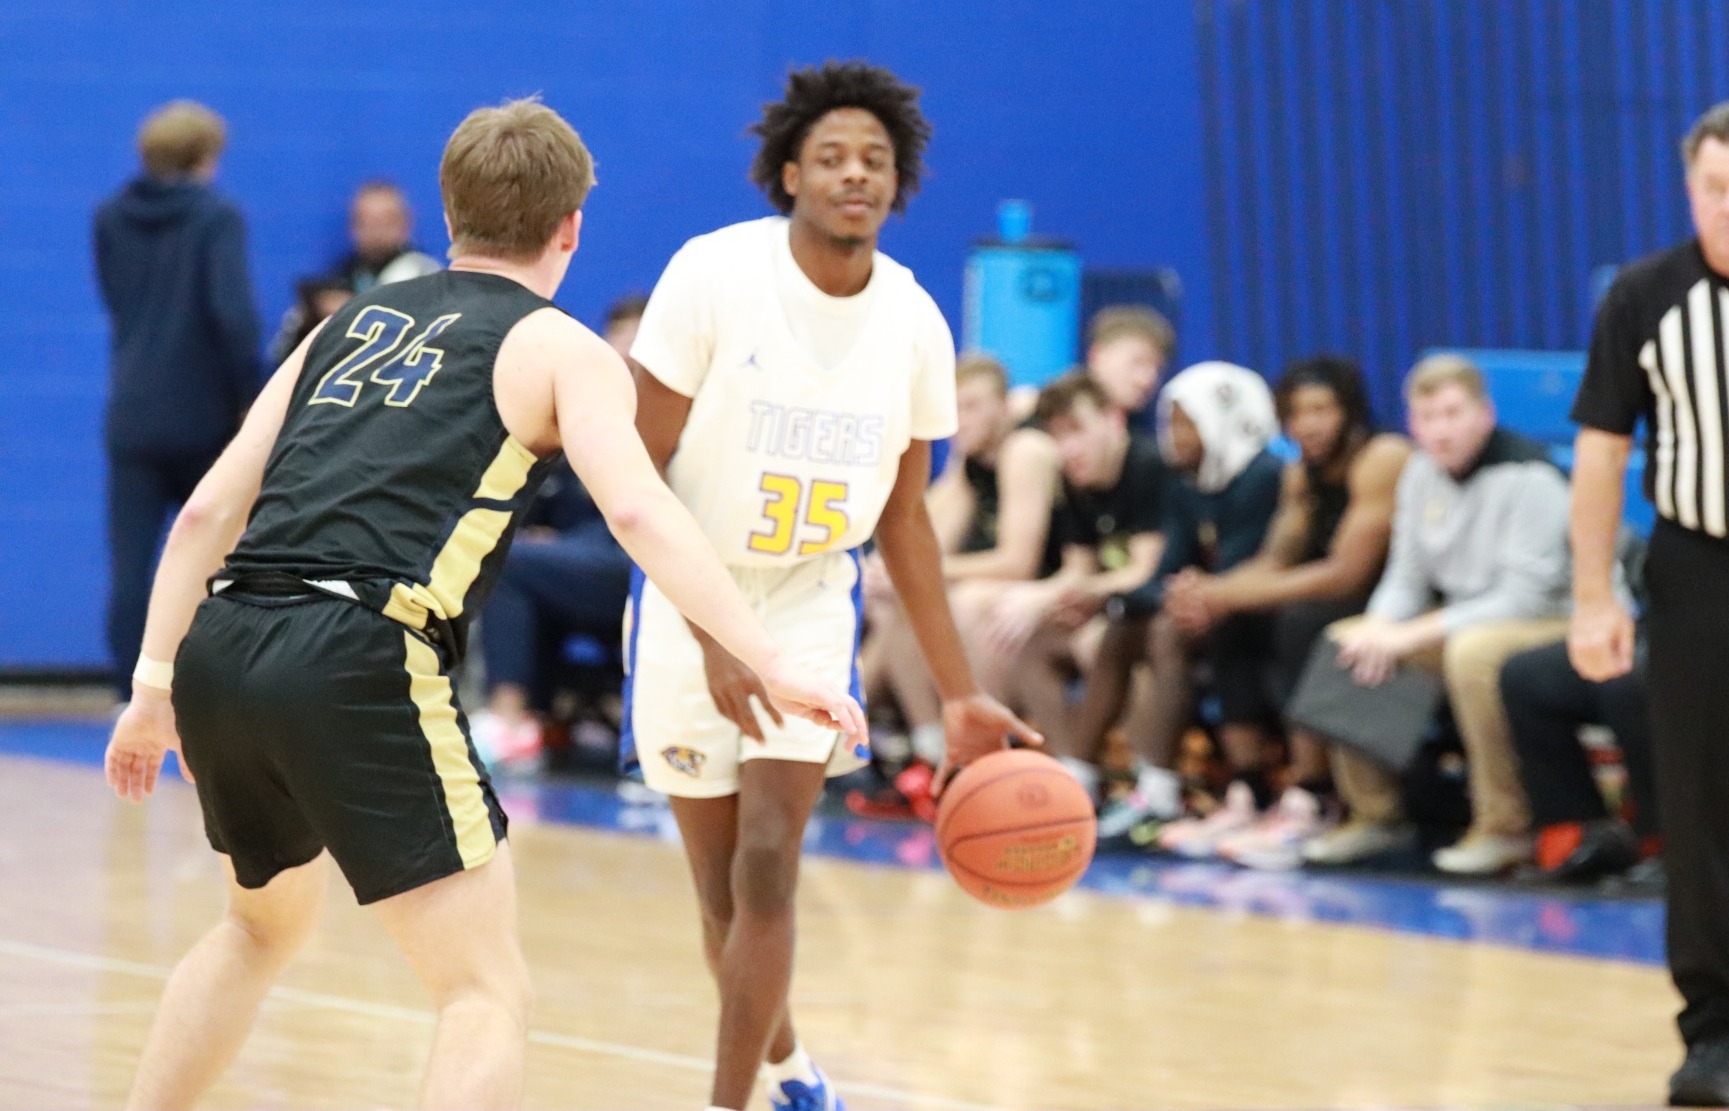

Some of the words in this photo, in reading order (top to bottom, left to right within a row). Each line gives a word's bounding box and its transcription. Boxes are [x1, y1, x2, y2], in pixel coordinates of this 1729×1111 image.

[307, 304, 462, 408] 24
[747, 400, 884, 466] TIGERS
[747, 471, 850, 557] 35
